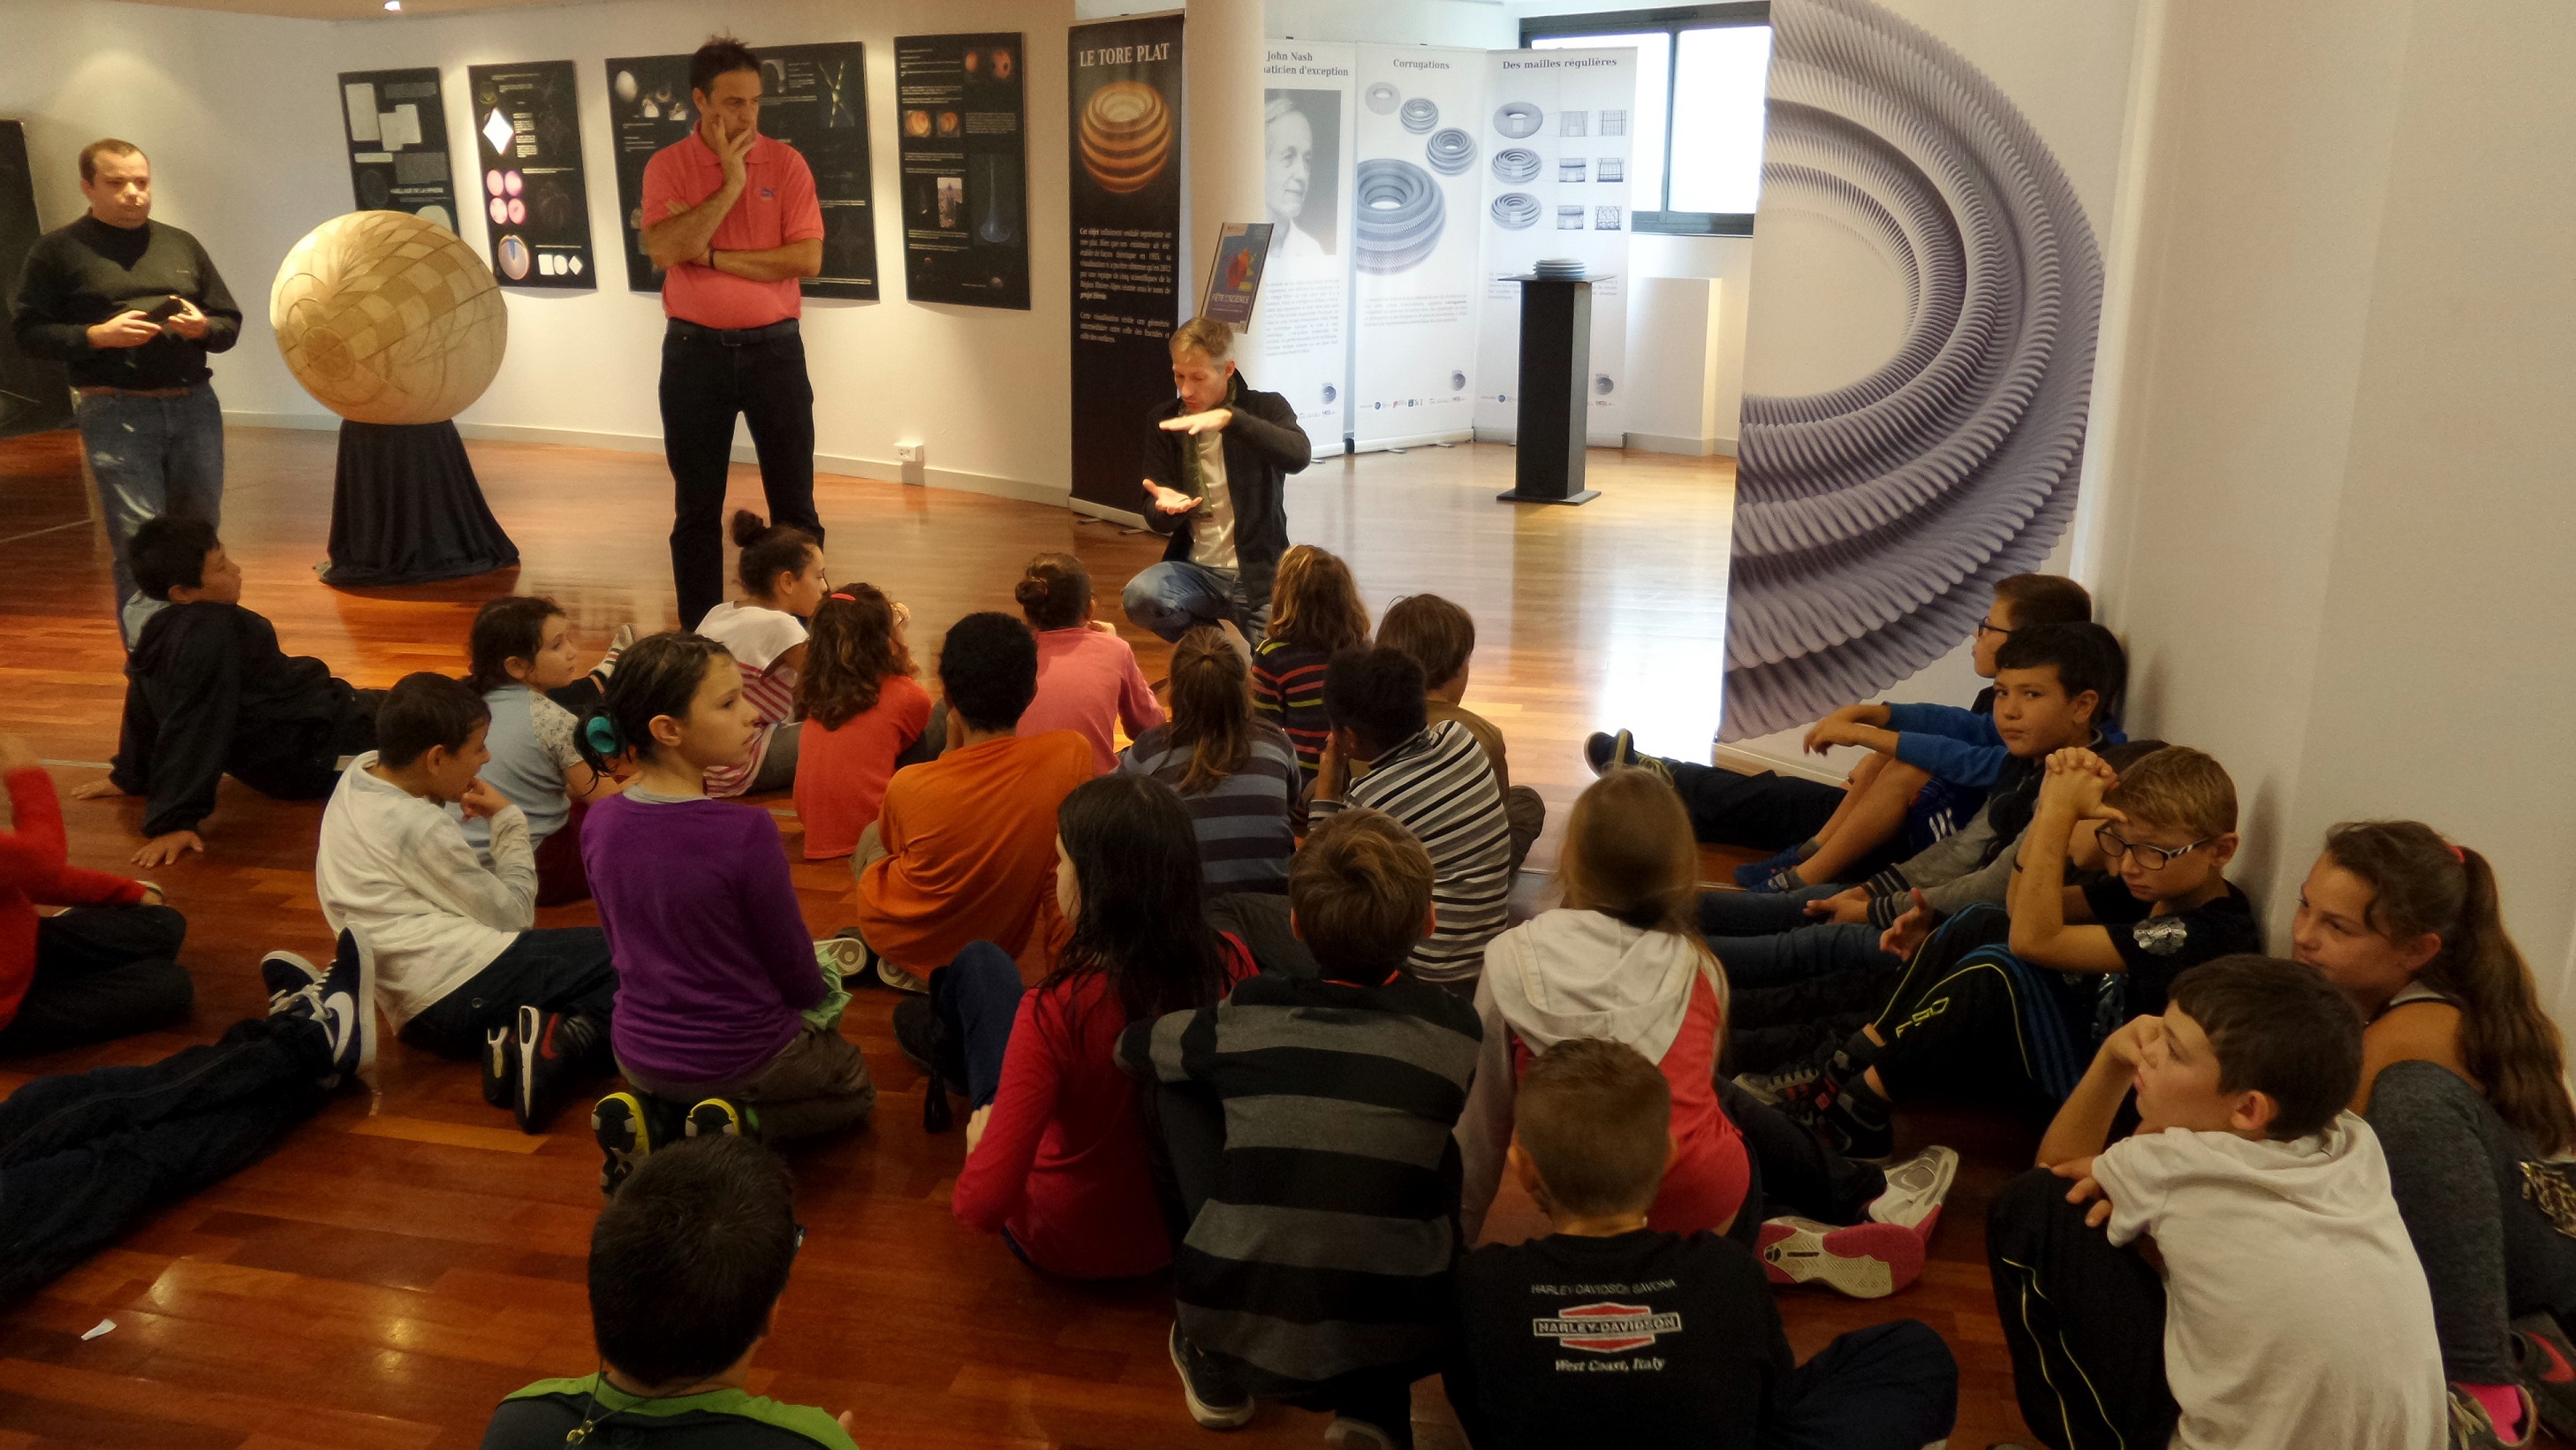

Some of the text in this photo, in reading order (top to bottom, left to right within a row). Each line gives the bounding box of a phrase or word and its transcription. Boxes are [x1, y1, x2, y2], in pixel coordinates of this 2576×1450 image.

[1080, 43, 1170, 67] LE TORE PLAT
[1266, 51, 1313, 62] John Nash
[1393, 58, 1450, 70] Corrugations
[1524, 59, 1561, 69] mailles
[1564, 57, 1617, 69] régulières
[1263, 65, 1349, 77] aticien d'exception
[1555, 1359, 1586, 1371] West
[1633, 1355, 1665, 1371] Italy
